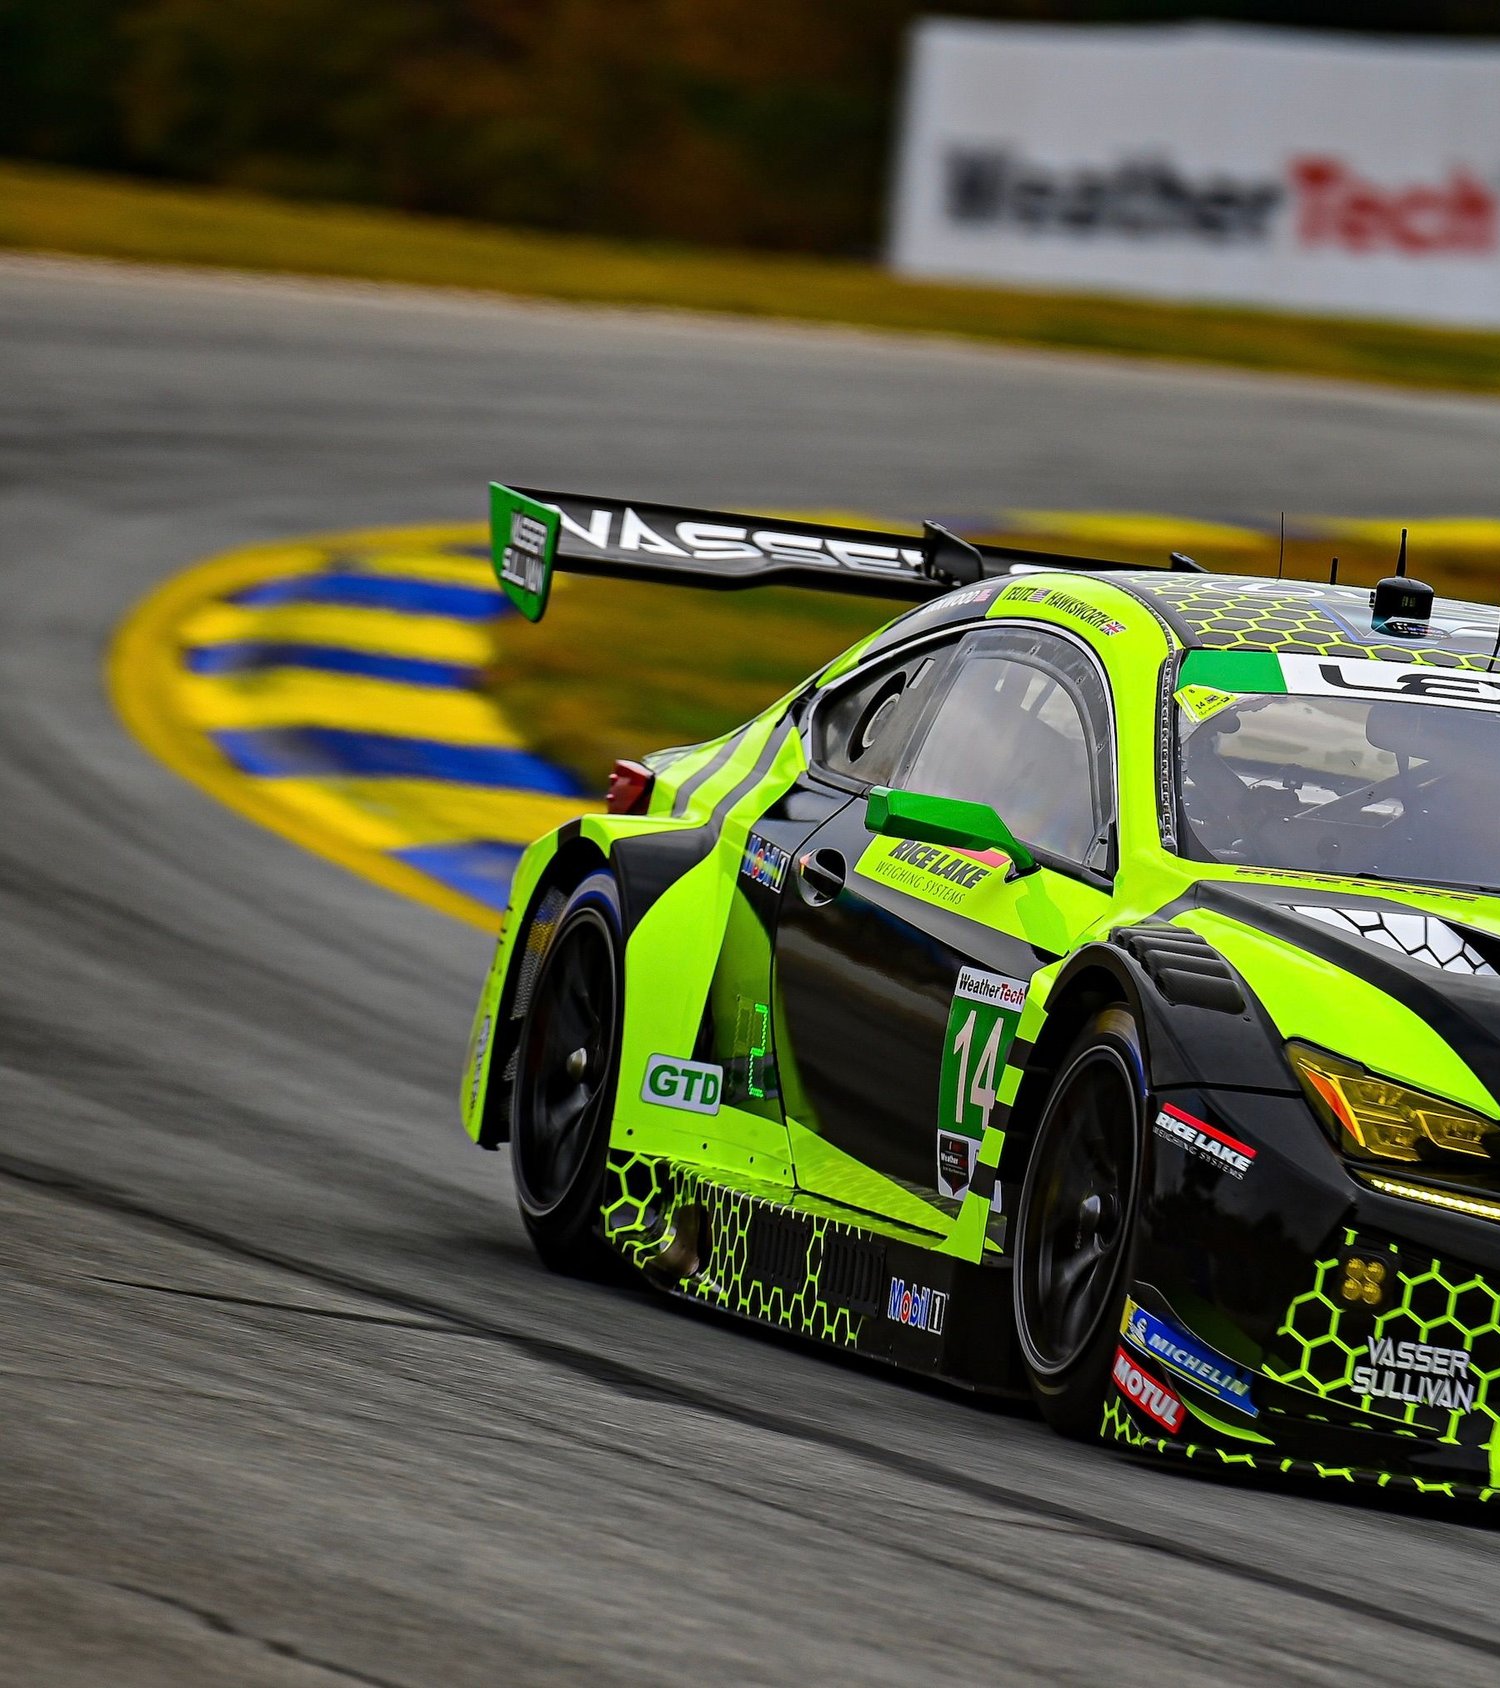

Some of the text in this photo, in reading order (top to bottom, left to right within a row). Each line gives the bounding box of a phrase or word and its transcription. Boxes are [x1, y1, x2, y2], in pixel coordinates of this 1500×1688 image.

[944, 144, 1500, 257] WeatherTech
[1044, 591, 1113, 630] HAWKSWORTH
[875, 860, 966, 906] WEIGHING SYSTEMS
[888, 839, 990, 890] RICE LAKE
[958, 972, 1025, 1006] WeatherTech
[648, 1064, 720, 1107] GTD
[953, 1009, 996, 1131] 14
[1155, 1111, 1254, 1173] RICE LAKE
[886, 1276, 931, 1332] Mobil
[1148, 1332, 1250, 1398] MICHELIN
[1367, 1335, 1471, 1380] VASSER
[1113, 1354, 1181, 1427] MOTUL
[1350, 1365, 1475, 1415] SULLIVAN
